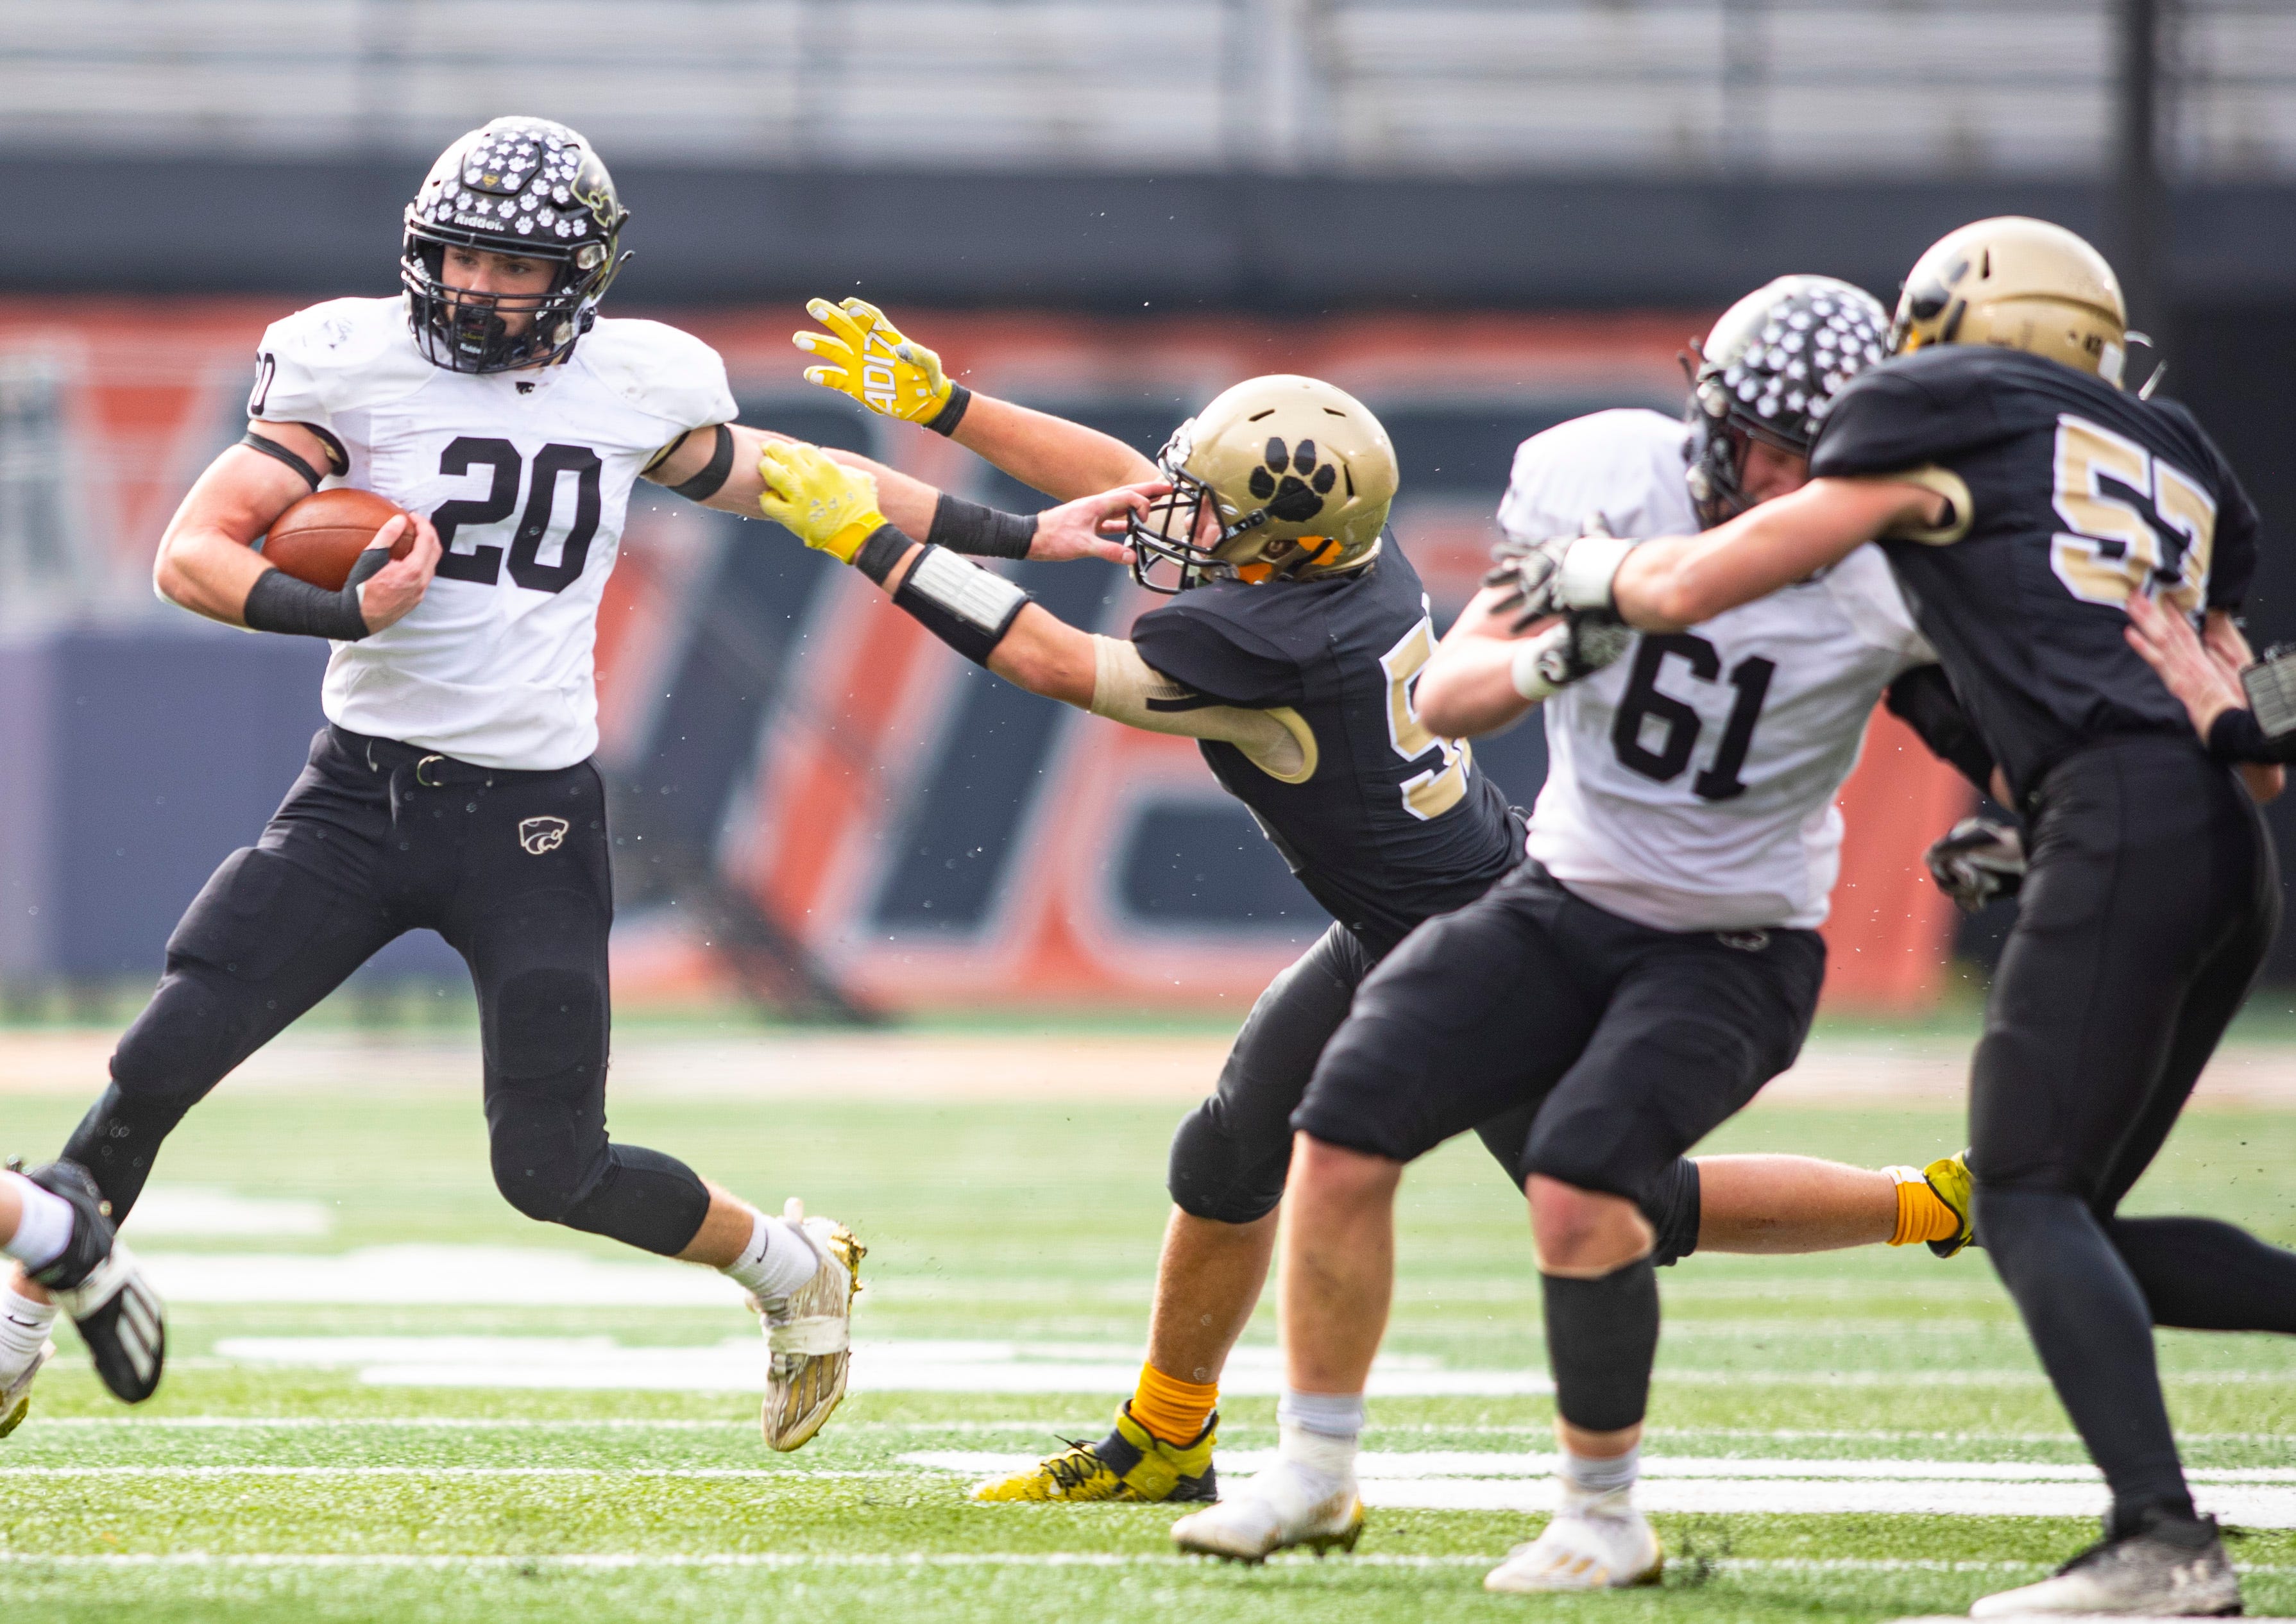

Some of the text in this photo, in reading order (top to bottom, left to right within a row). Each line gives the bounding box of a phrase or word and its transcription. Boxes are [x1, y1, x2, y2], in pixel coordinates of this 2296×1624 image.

[431, 436, 602, 594] 20
[1379, 592, 1473, 822] 5
[1610, 632, 1776, 800] 61
